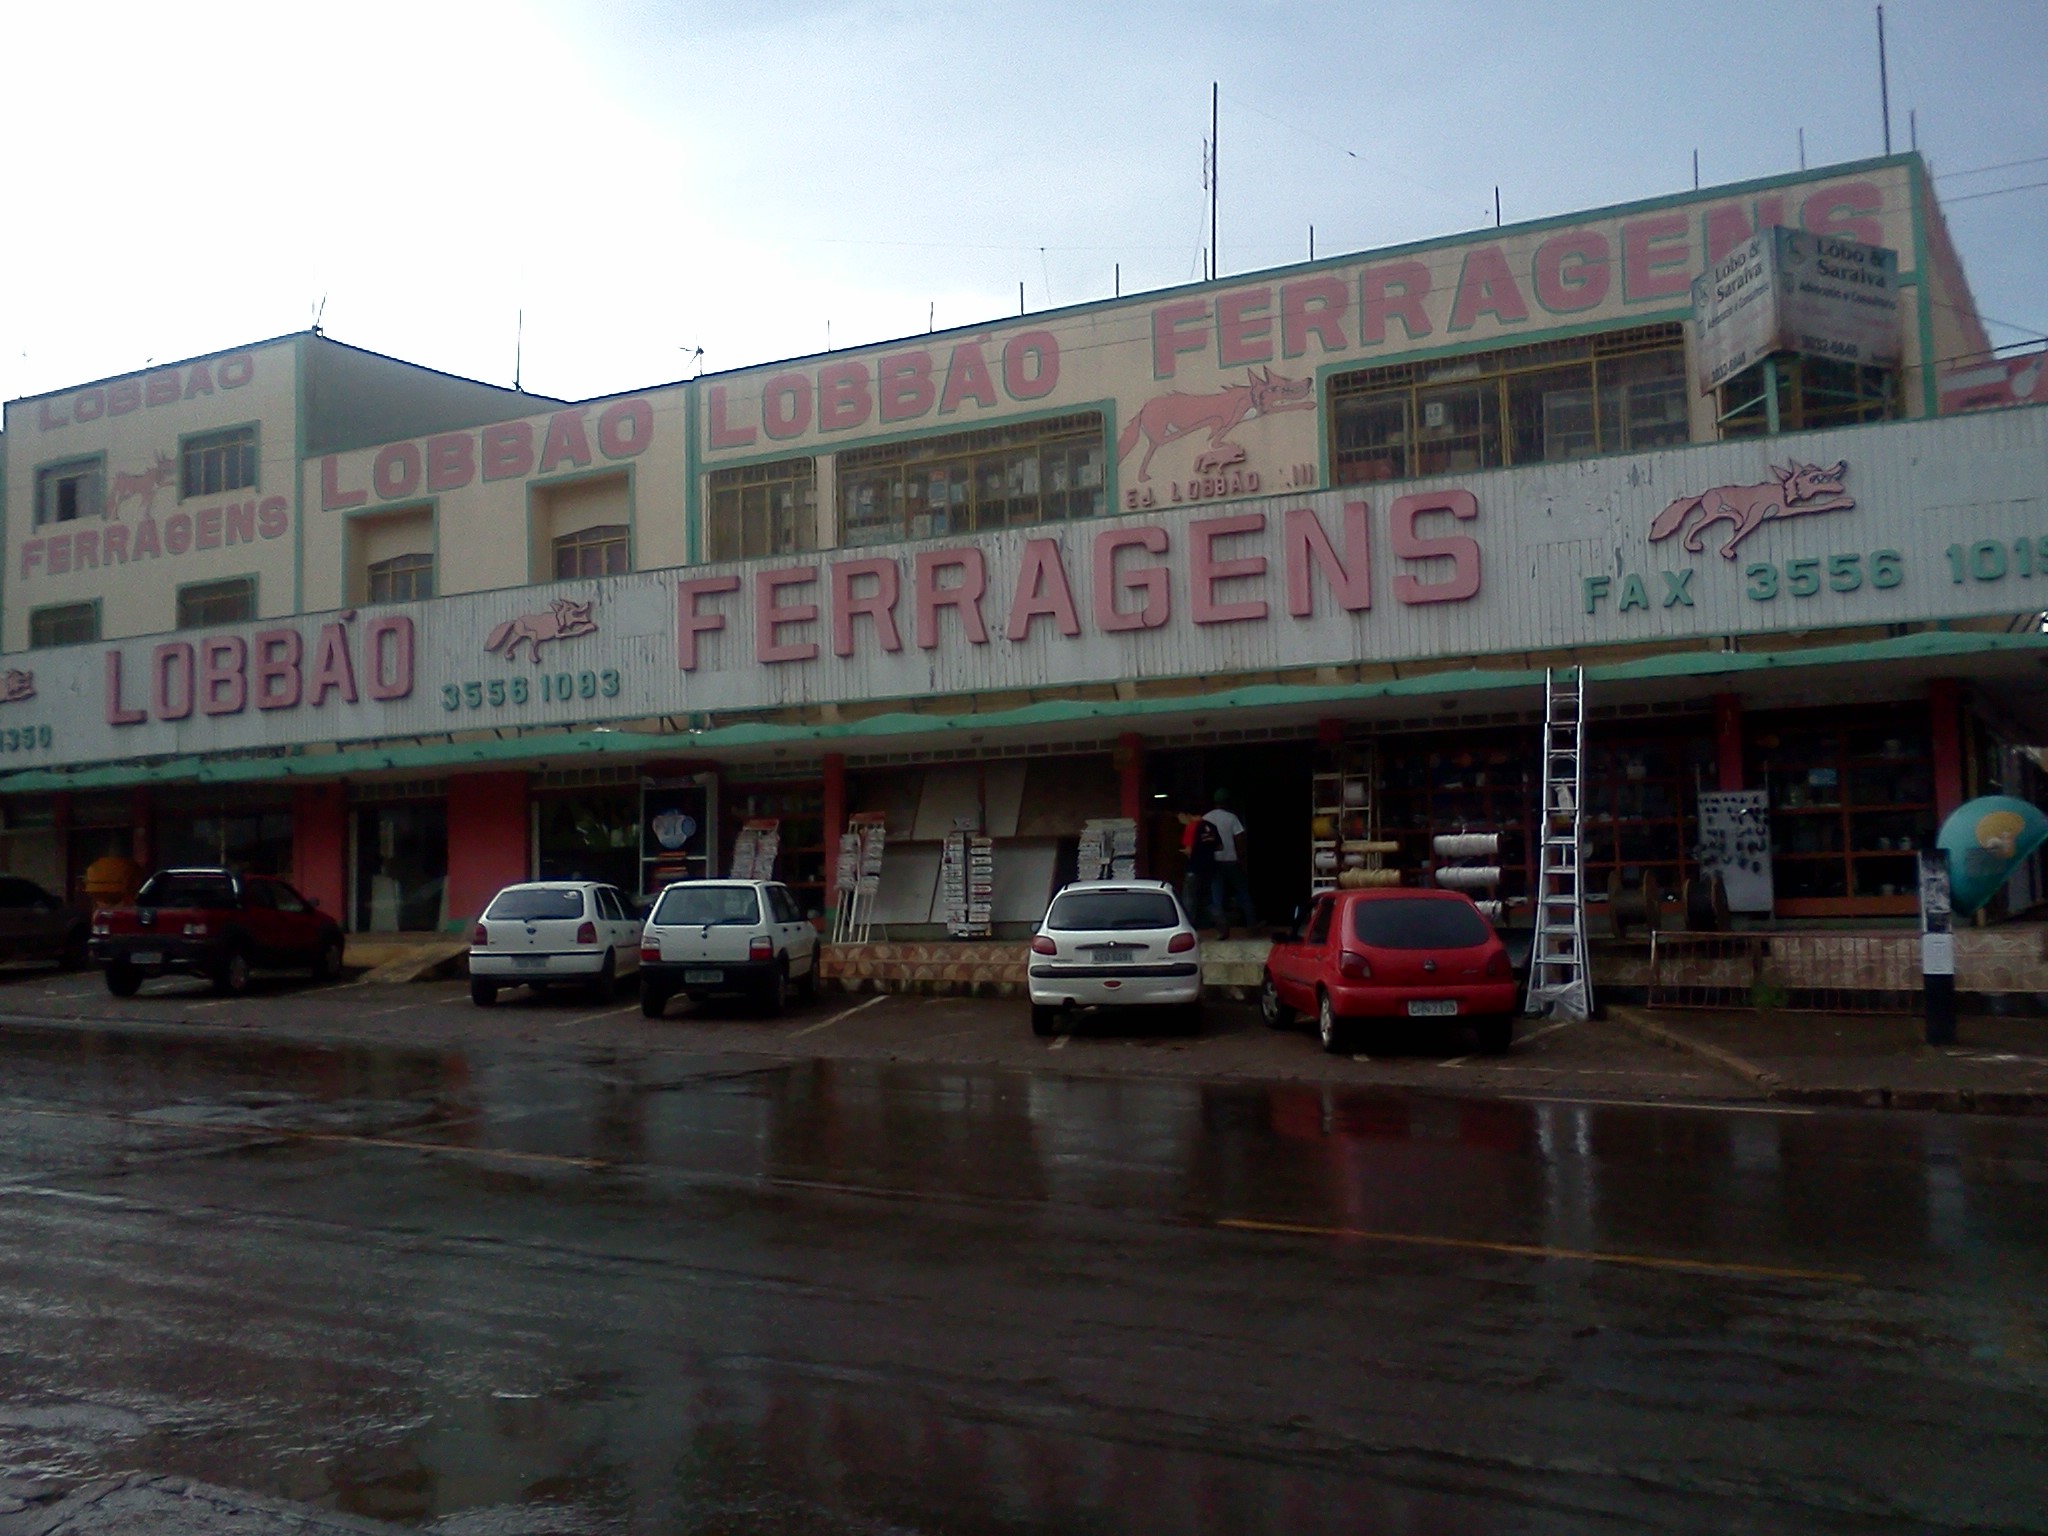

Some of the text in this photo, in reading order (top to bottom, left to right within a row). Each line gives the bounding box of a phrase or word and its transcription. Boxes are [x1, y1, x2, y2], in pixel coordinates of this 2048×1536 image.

[1152, 181, 1886, 380] FERRAGENS
[1716, 262, 1764, 303] Saraiva
[1817, 258, 1885, 288] Saraiva
[20, 495, 289, 580] FERRAGENS
[1583, 535, 2048, 615] FAX 3556 101
[677, 488, 1482, 671] FERRAGENS
[441, 668, 620, 712] 3556 1093
